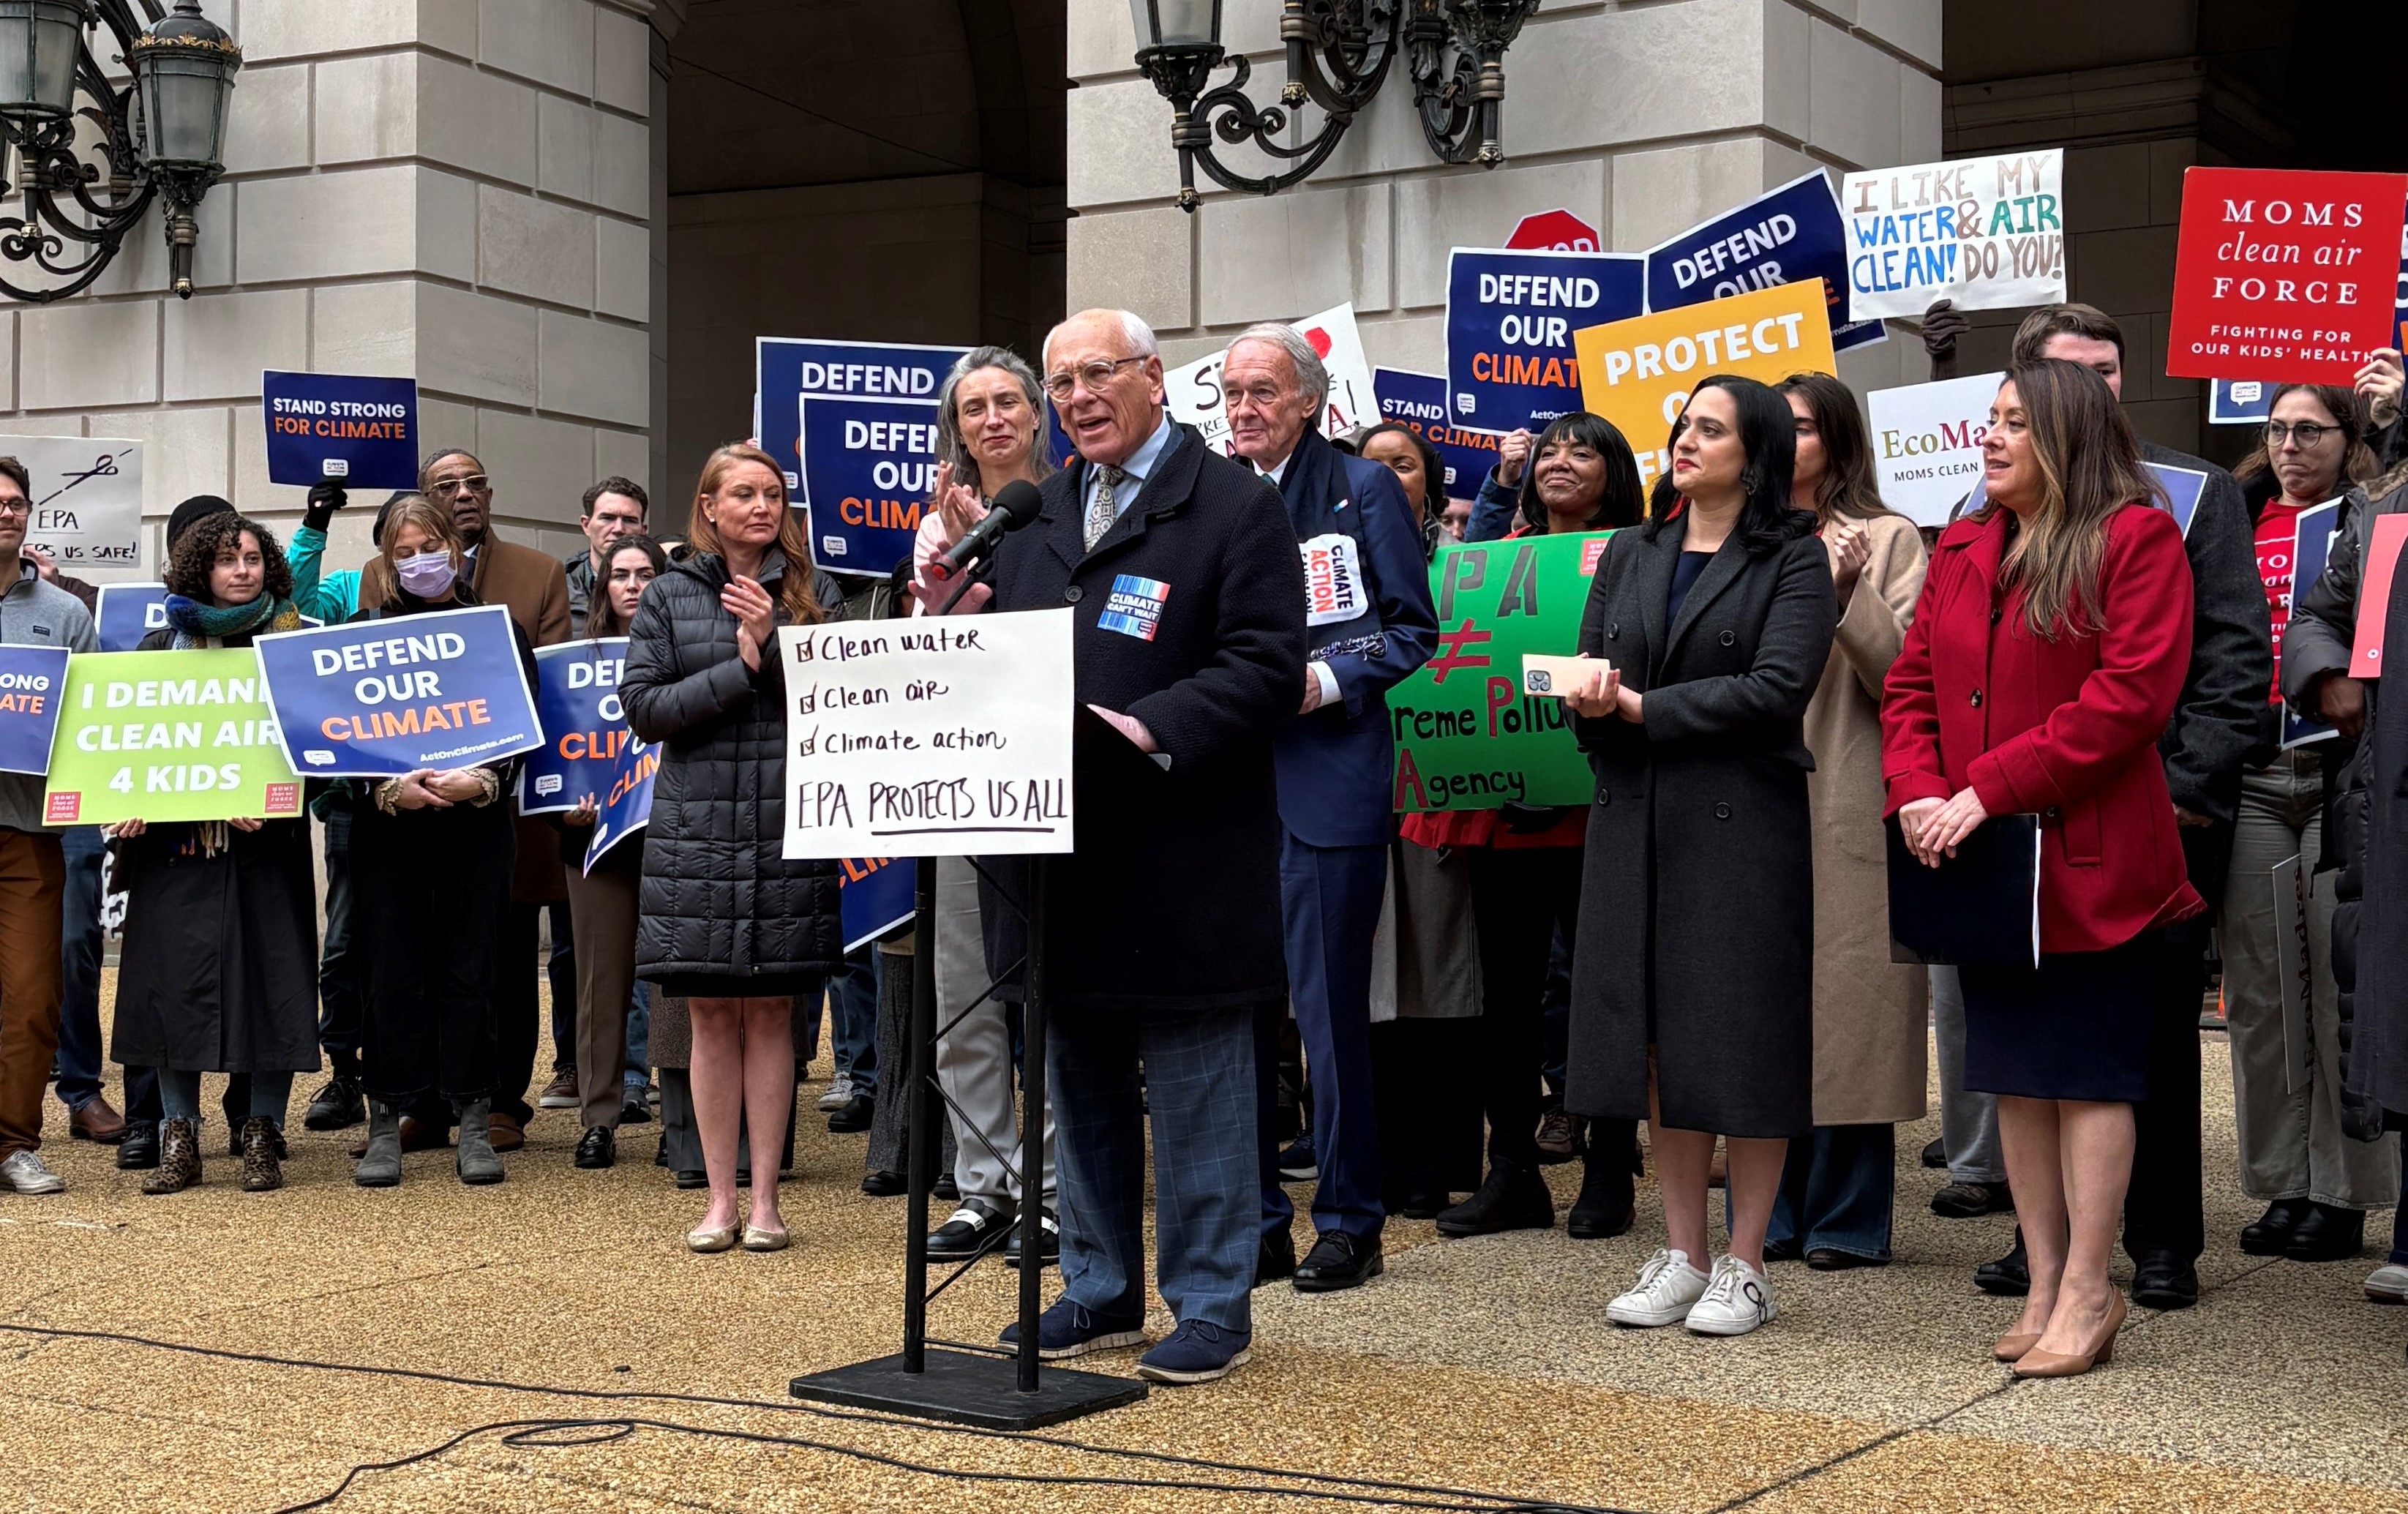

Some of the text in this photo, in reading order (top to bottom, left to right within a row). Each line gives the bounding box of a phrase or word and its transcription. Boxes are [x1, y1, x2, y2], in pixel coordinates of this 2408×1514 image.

[1853, 154, 2052, 214] I LIKE MY
[1853, 206, 1956, 248] WATER
[1989, 194, 2060, 236] AIR
[2222, 199, 2363, 228] MOMS
[1672, 213, 1796, 289] DEFEND
[1853, 243, 1957, 293] CLEAN!
[1963, 241, 1999, 282] DO
[2006, 235, 2063, 280] YOU?
[2217, 231, 2362, 266] clean air
[1479, 273, 1599, 308] DEFEND
[2212, 277, 2358, 304] FORCE
[1500, 315, 1567, 348] OUR
[2210, 325, 2351, 342] FIGHTING FOR
[1604, 312, 1803, 386] PROTECT
[2191, 342, 2374, 363] OUR KIDS' HEALTH
[802, 361, 935, 394] DEFEND
[274, 397, 405, 418] STAND STRONG
[1383, 398, 1444, 420] STAND
[274, 417, 405, 439] FOR CLIMATE
[1894, 462, 1978, 481] MOMS CLEAN
[39, 509, 78, 530] EPA
[65, 546, 84, 558] US
[92, 541, 136, 559] SAFE!
[1311, 550, 1335, 613] ACTION
[1331, 544, 1354, 610] CLIMATE
[1110, 593, 1162, 612] CLIMATE
[1134, 608, 1158, 621] WAIT
[312, 632, 466, 677] DEFEND
[822, 635, 888, 662] Clean
[82, 683, 94, 709] I
[355, 670, 443, 705] OUR
[824, 686, 889, 708] Clean
[76, 719, 280, 752] CLEAN AIR
[321, 698, 491, 742] CLIMATE
[420, 733, 524, 762] ActOnClimate.com
[825, 727, 1006, 754] Climate action
[108, 763, 241, 794] 4 KIDS
[1394, 748, 1526, 809] Agency
[798, 777, 1068, 829] EPA PROTECTS US ALL
